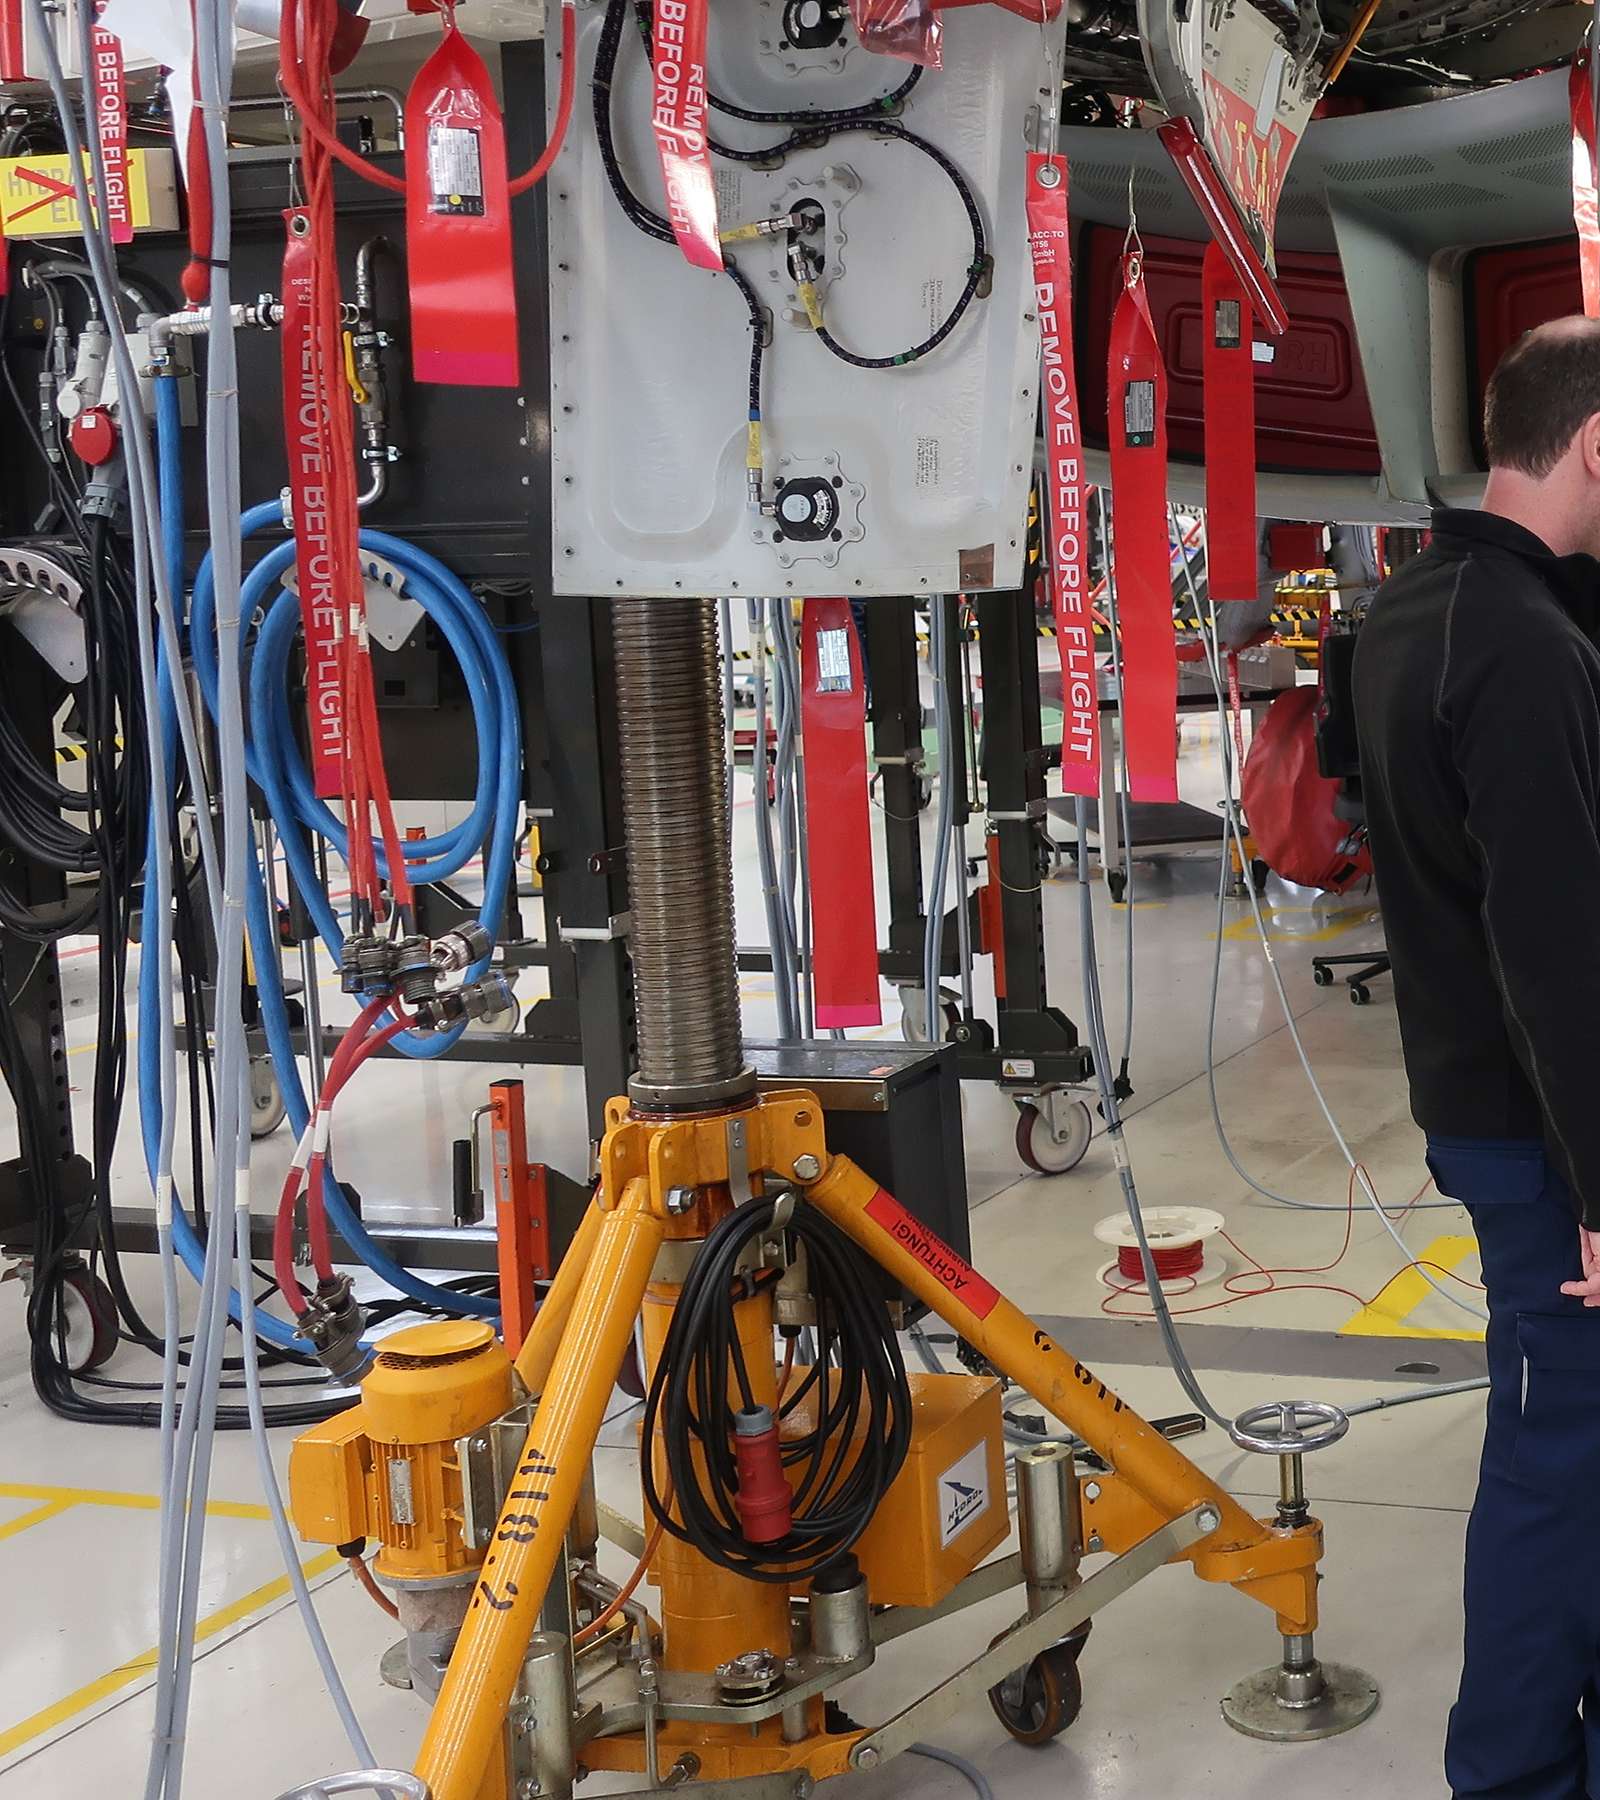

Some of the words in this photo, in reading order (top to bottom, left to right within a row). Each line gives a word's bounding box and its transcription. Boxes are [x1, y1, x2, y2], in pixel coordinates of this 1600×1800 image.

[97, 52, 121, 140] BEFORE
[655, 0, 688, 127] BEFORE
[101, 147, 126, 223] FLIGHT
[1058, 458, 1083, 613] BEFORE
[1063, 624, 1093, 761] FLIGHT
[891, 1219, 968, 1290] ACHTUNG!
